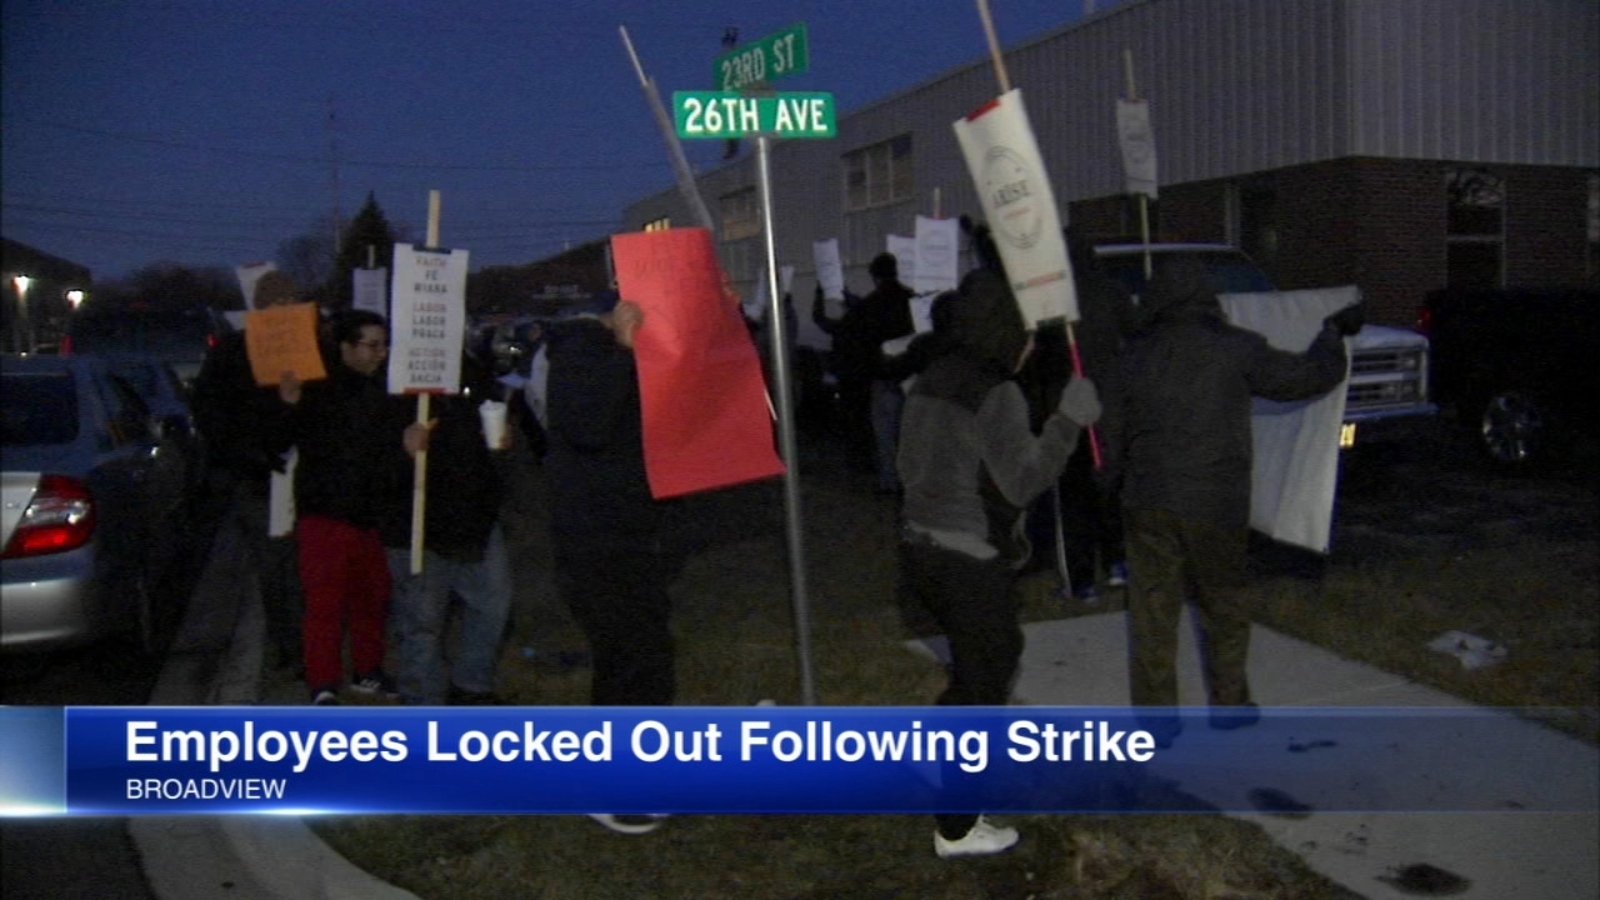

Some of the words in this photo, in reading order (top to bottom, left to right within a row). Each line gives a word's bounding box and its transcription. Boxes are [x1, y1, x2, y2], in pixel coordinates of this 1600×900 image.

[721, 47, 766, 91] 23RD
[773, 33, 795, 73] ST
[684, 97, 759, 132] 26TH
[775, 98, 828, 132] AVE
[416, 257, 447, 267] FAITH
[425, 270, 438, 280] FE
[413, 302, 446, 312] LABOR
[413, 316, 445, 326] LABOR
